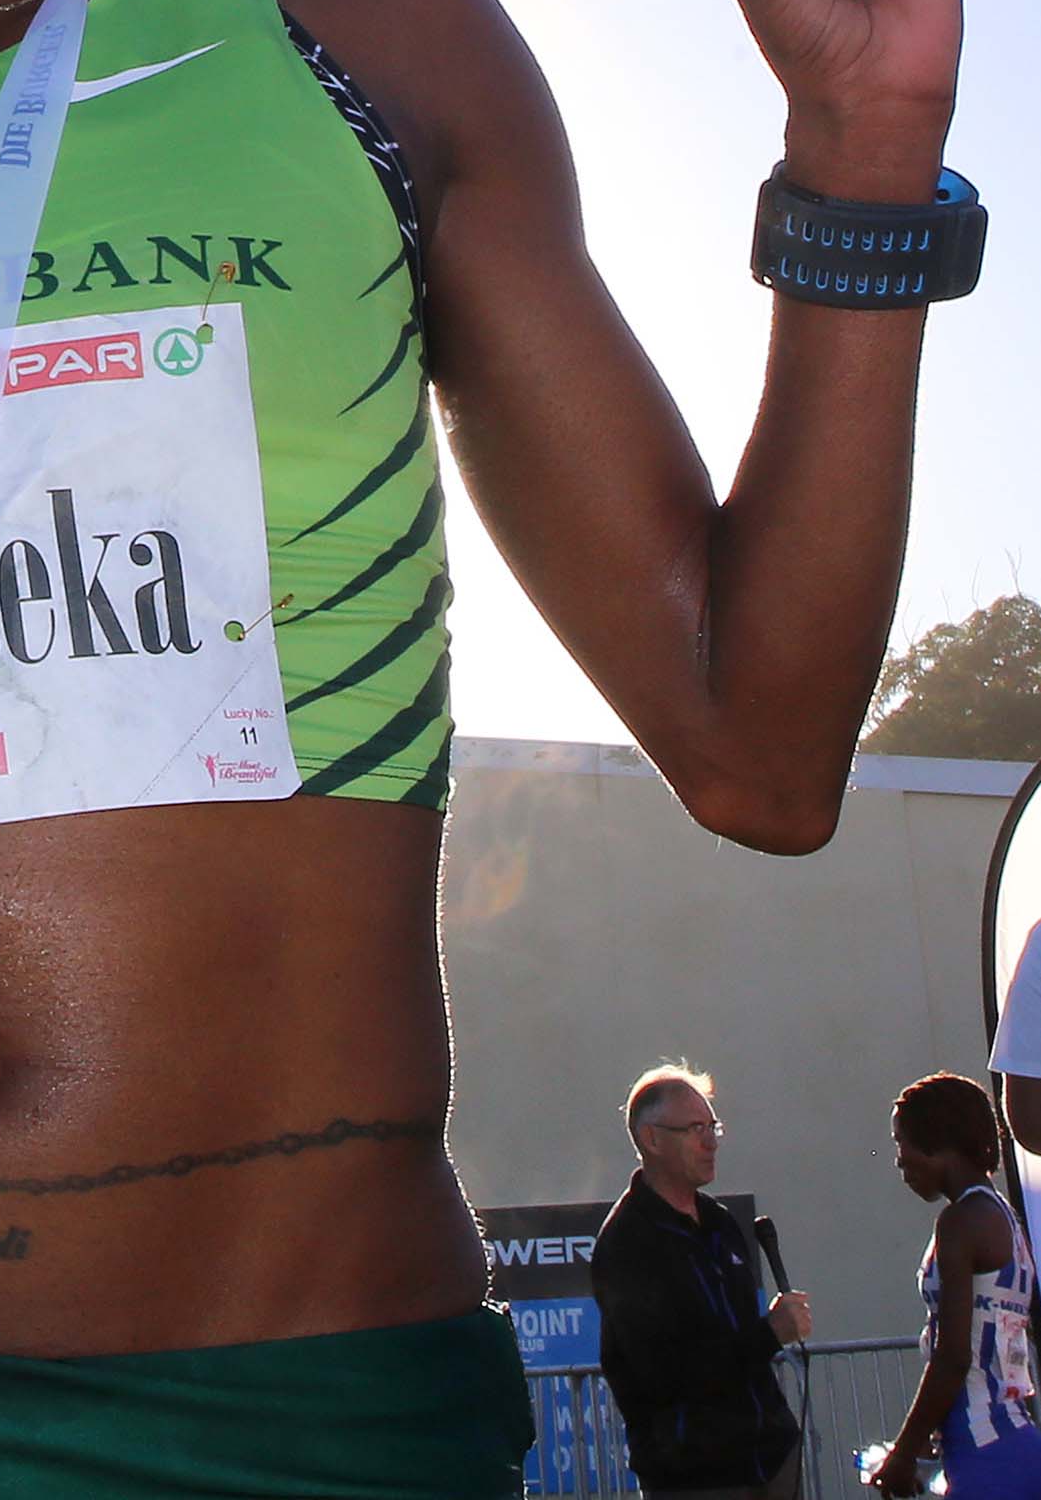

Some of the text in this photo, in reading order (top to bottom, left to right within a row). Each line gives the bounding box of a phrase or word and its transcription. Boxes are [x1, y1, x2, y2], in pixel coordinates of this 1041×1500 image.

[9, 341, 137, 387] PAR
[224, 708, 253, 721] Lucky
[240, 727, 258, 745] 11
[220, 766, 277, 783] Beautiful
